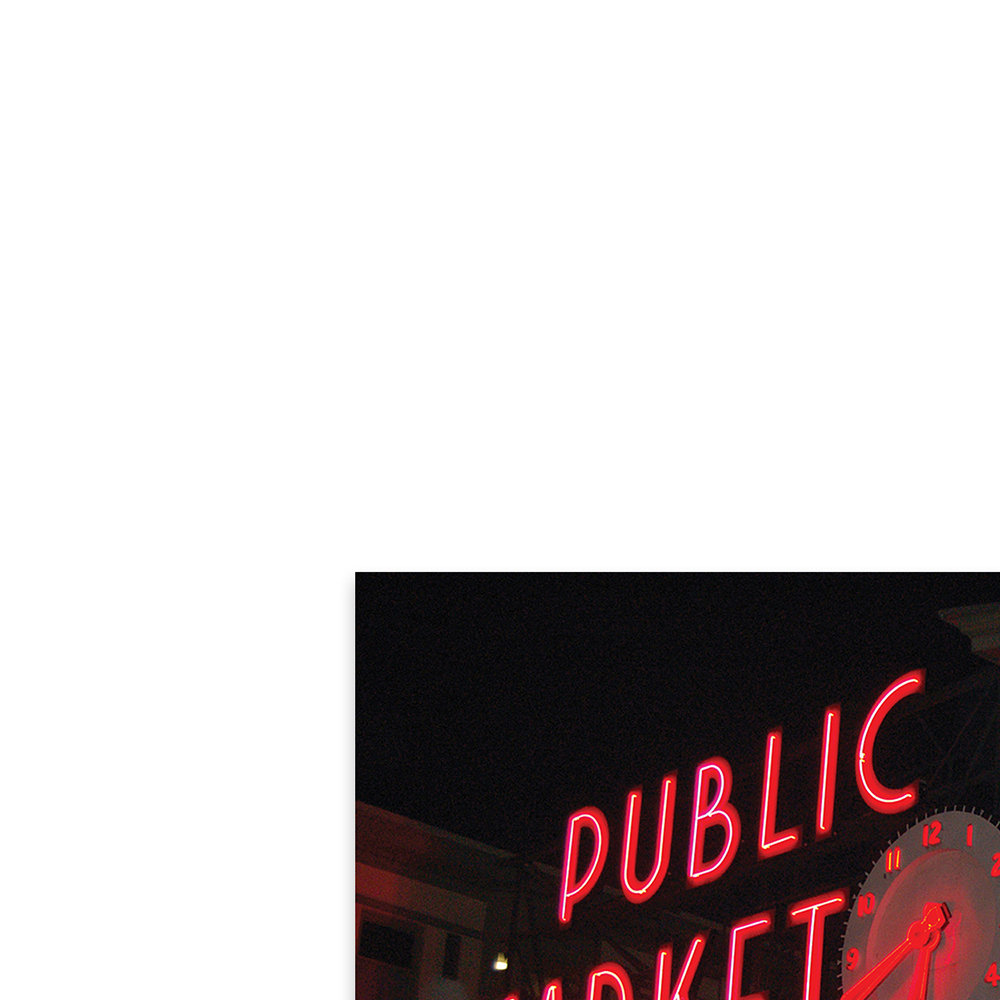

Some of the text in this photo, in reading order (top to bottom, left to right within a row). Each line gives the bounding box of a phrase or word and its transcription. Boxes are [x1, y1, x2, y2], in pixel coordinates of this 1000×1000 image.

[558, 670, 924, 926] PUBLIC
[922, 820, 942, 847] 12
[966, 824, 973, 847] 1
[885, 847, 900, 873] 11
[857, 892, 875, 917] 10
[846, 948, 859, 970] 9
[984, 962, 1000, 986] 4
